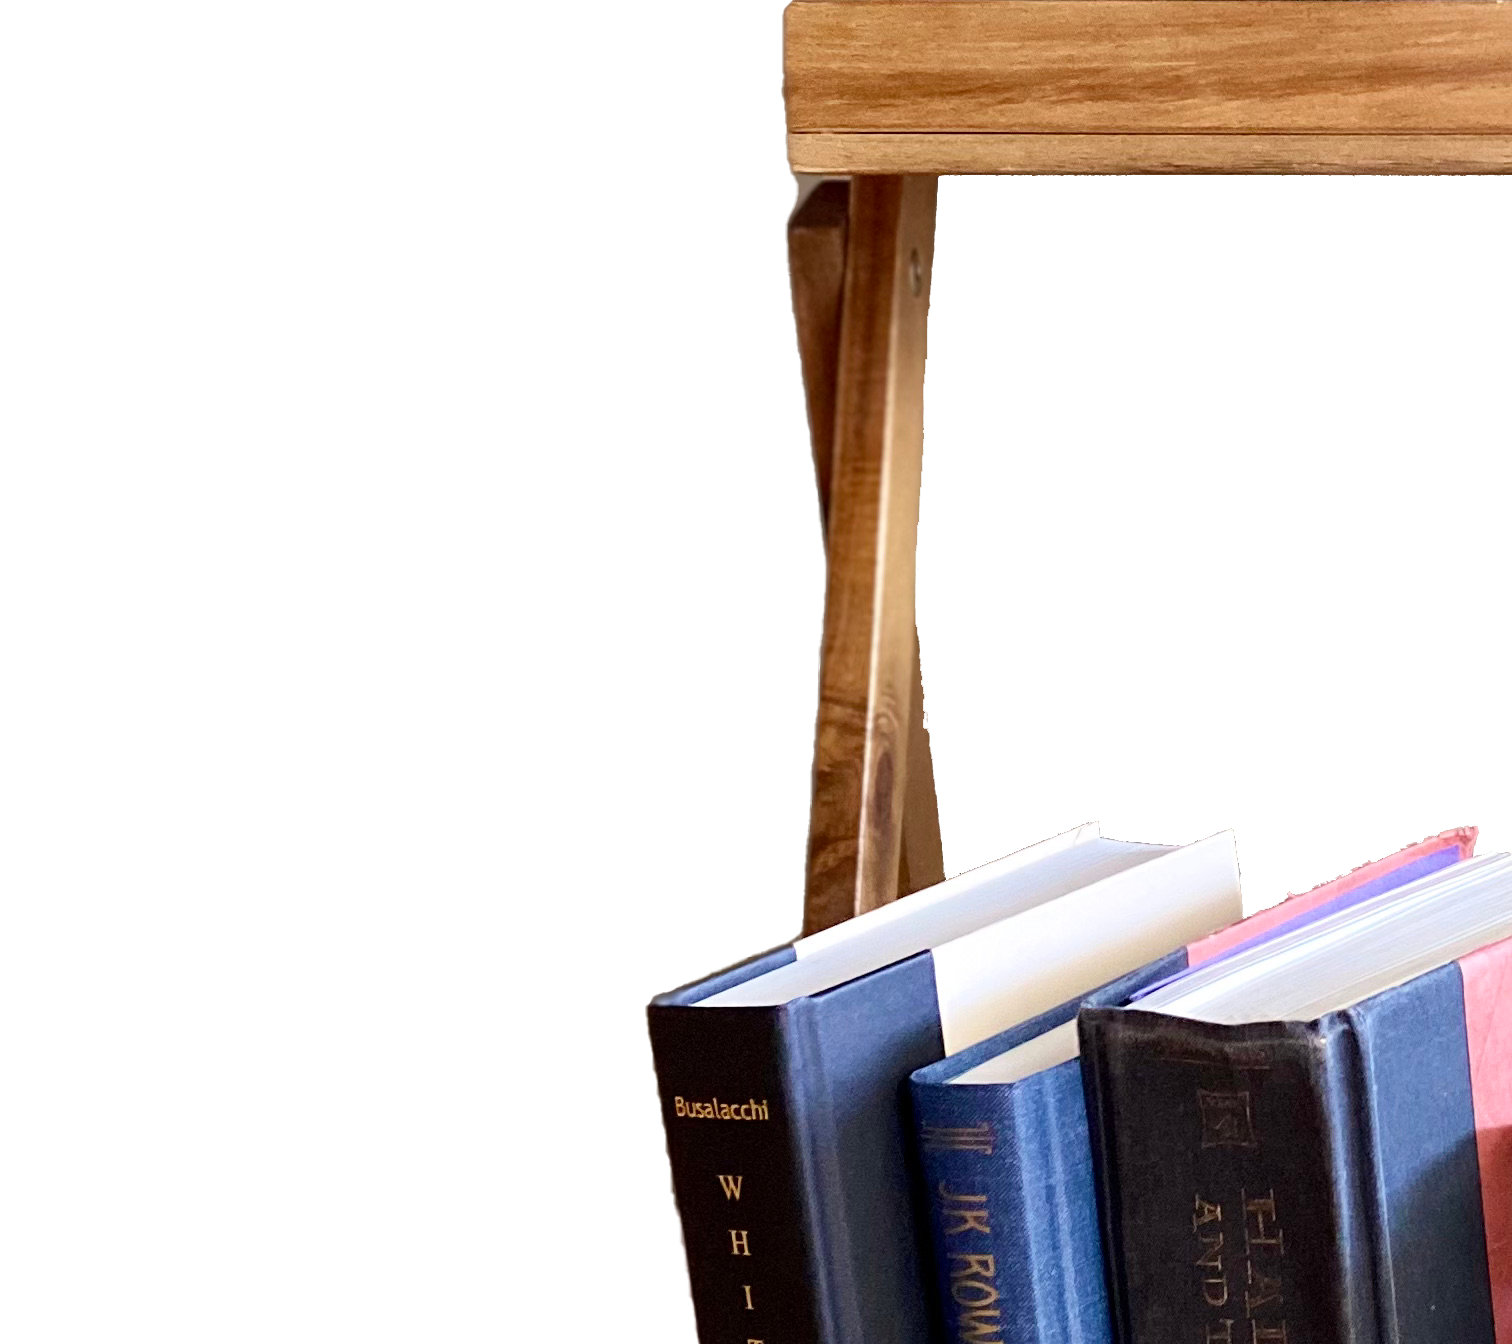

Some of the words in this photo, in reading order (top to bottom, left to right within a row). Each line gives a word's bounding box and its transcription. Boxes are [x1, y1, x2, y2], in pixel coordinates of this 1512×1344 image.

[675, 1095, 768, 1122] Busalacchi
[938, 1179, 989, 1236] JK
[1191, 1193, 1228, 1308] AND
